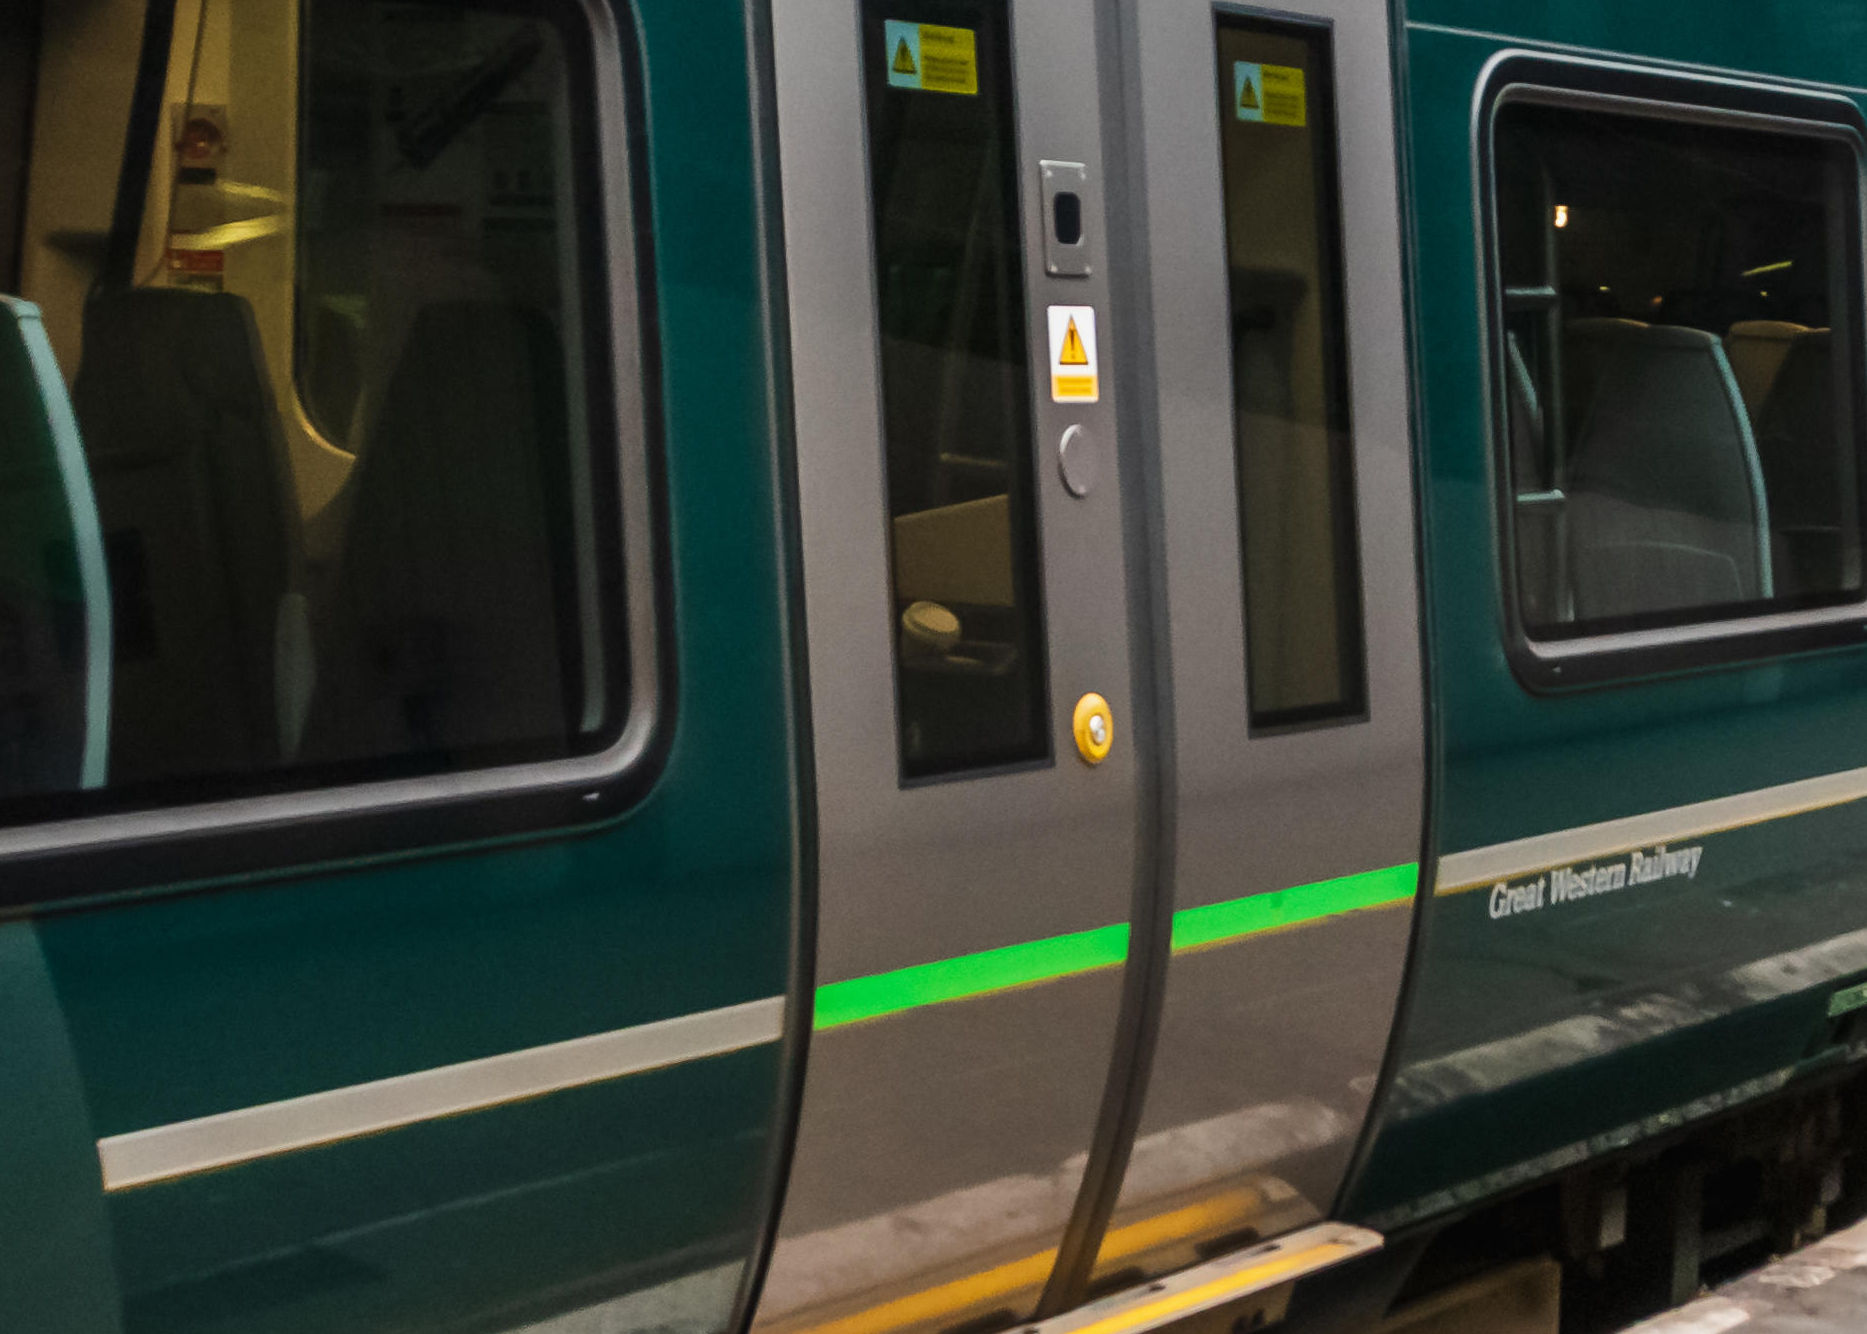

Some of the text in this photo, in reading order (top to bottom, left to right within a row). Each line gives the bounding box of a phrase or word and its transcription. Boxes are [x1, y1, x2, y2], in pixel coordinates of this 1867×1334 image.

[1488, 844, 1704, 920] Great Western Railway
